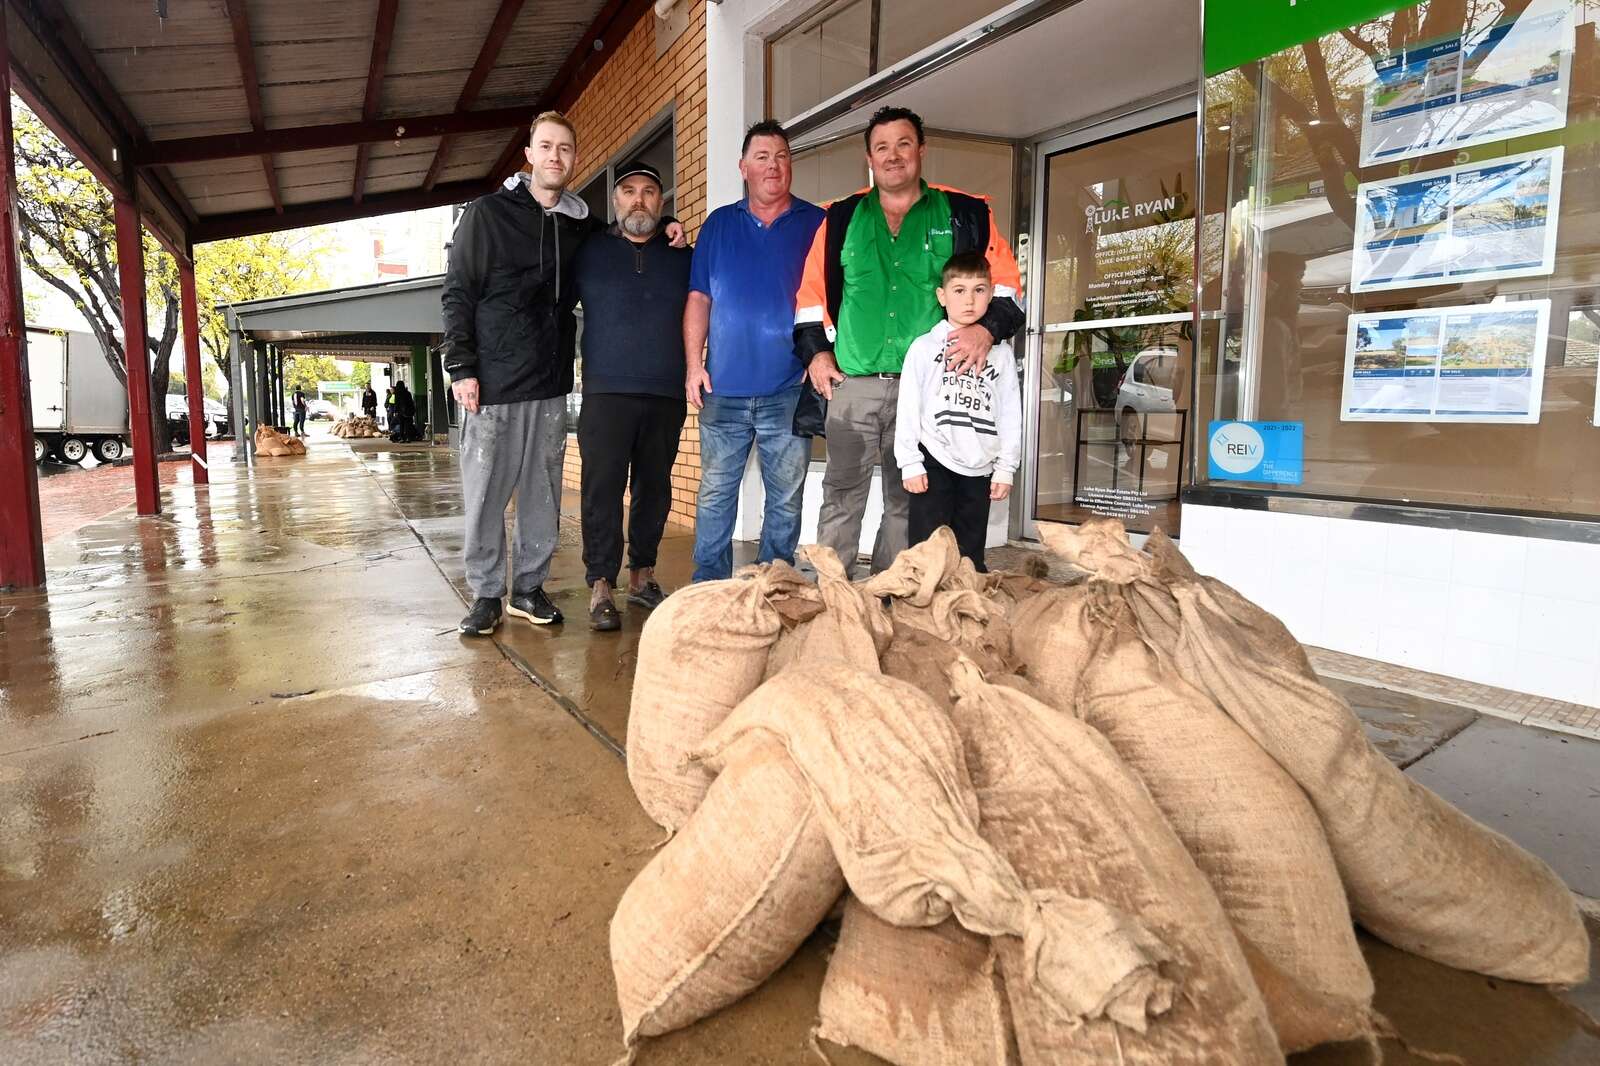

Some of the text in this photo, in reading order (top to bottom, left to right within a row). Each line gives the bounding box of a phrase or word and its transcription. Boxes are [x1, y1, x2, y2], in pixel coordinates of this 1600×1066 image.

[1445, 42, 1459, 50] SALE
[1094, 196, 1176, 225] LUKE RYAN
[1103, 271, 1123, 280] OFFICE
[1088, 281, 1110, 290] Monday
[1114, 279, 1132, 287] Friday
[1227, 443, 1257, 456] REIV
